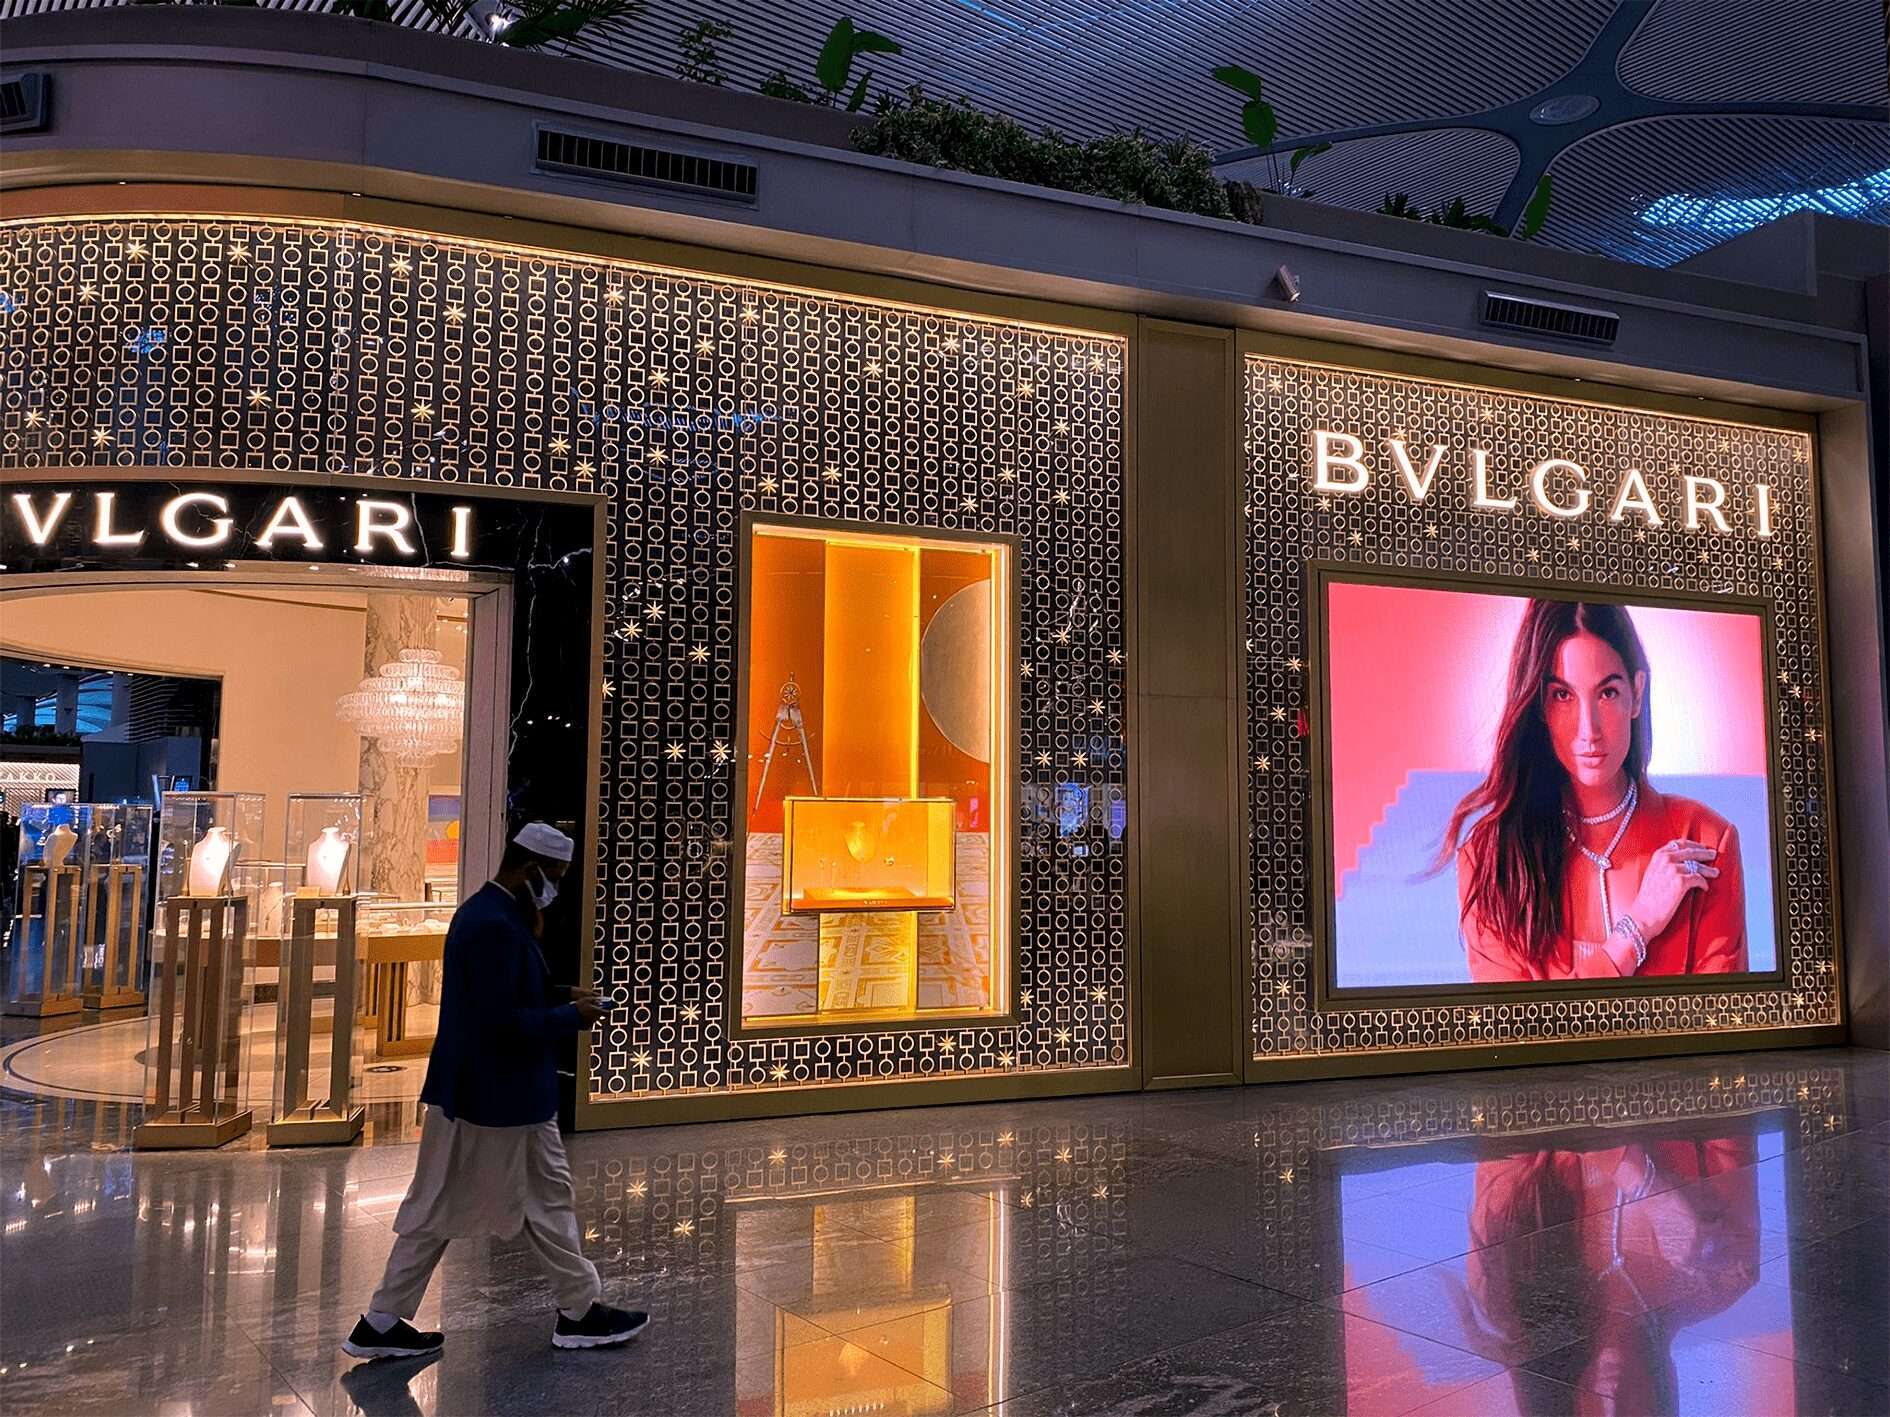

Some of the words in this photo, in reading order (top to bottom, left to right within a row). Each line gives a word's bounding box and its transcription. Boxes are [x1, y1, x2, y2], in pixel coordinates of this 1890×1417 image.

[1312, 430, 1775, 537] BVLGARI
[13, 492, 471, 557] VLGARI
[0, 772, 55, 782] AKKO
